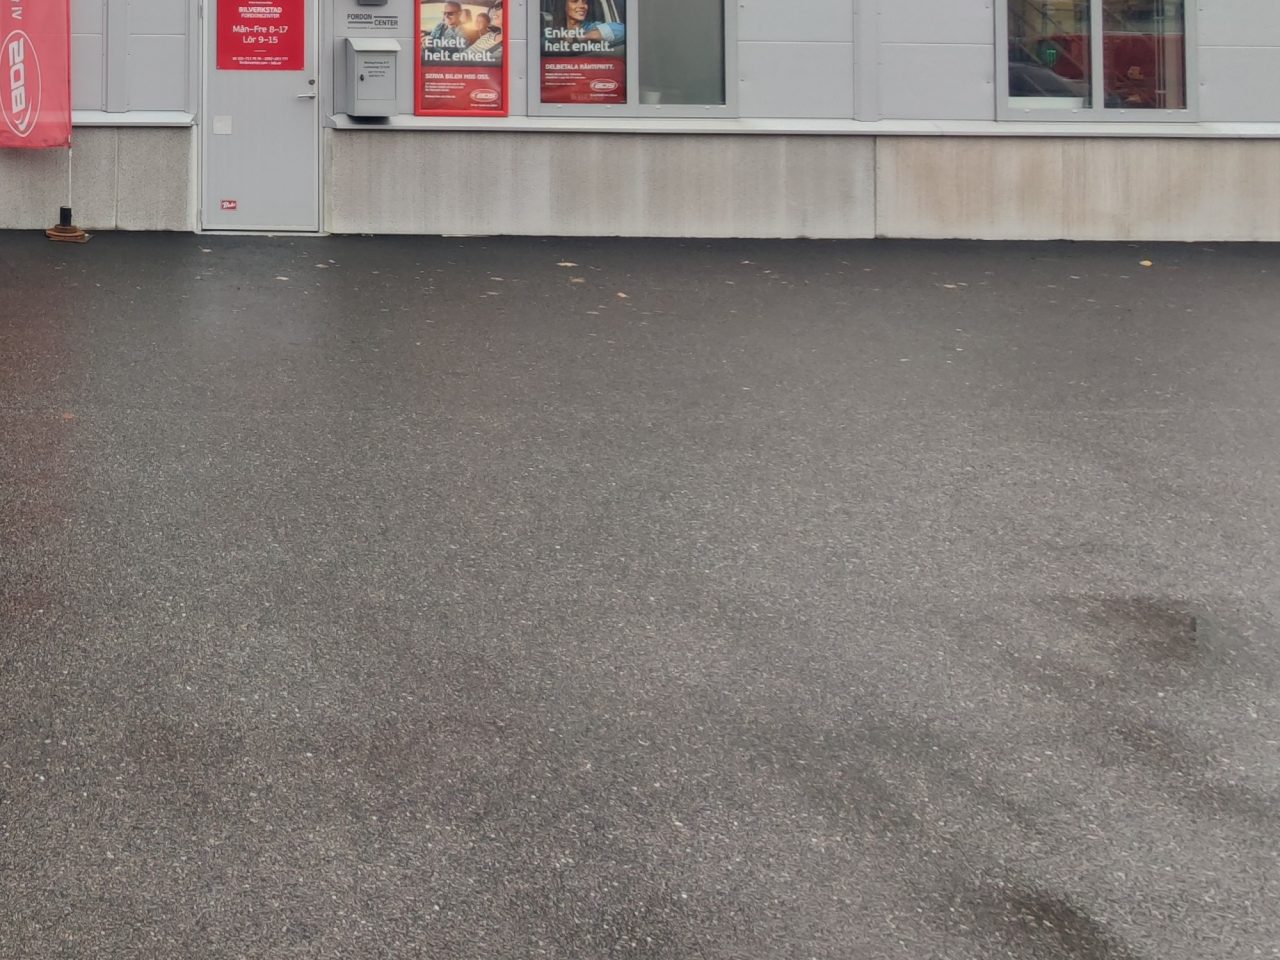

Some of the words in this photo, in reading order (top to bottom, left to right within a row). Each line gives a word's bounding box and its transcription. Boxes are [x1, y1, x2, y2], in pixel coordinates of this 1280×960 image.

[545, 27, 585, 38] Enkelt
[243, 36, 257, 44] Lör
[258, 36, 279, 44] 9-15
[425, 37, 465, 48] Enkelt
[545, 40, 571, 51] helt
[572, 40, 614, 52] enkelt.
[425, 50, 451, 61] helt
[452, 50, 496, 62] enkelt.
